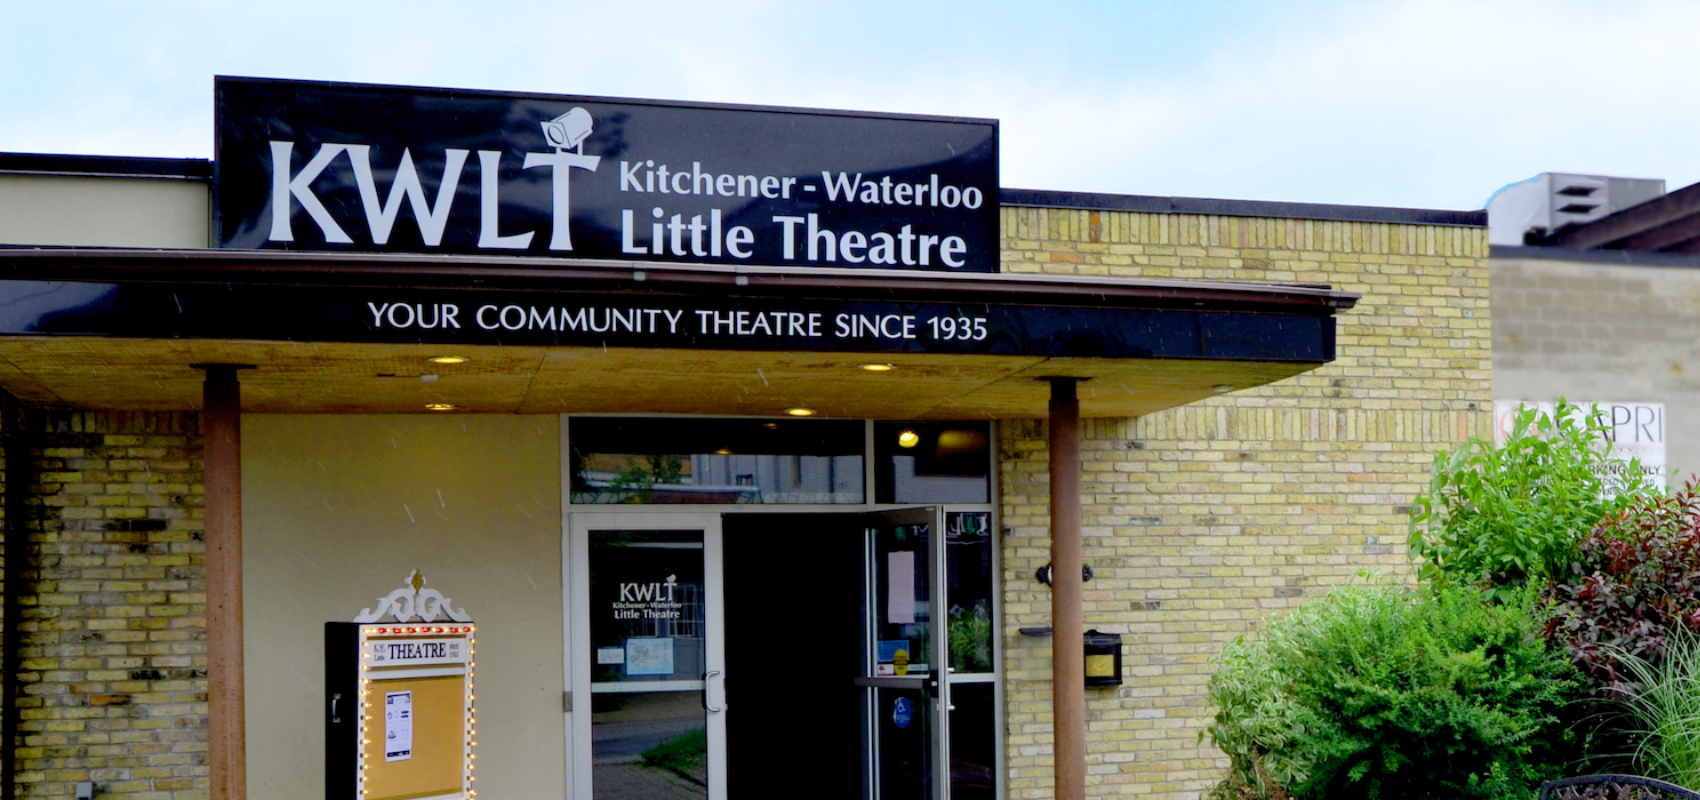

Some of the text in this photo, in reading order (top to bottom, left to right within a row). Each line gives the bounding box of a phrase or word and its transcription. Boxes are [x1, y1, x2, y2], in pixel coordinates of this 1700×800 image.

[268, 140, 602, 251] KWLT
[619, 159, 797, 200] Kitchener
[821, 170, 983, 209] Waterloo
[622, 207, 967, 268] Little Theatre
[367, 302, 988, 341] YOUR COMMUNITY THEATRE SINCE 1935
[619, 582, 678, 602] KWLT
[614, 609, 681, 619] Little Theatre
[388, 642, 447, 660] THEATRE
